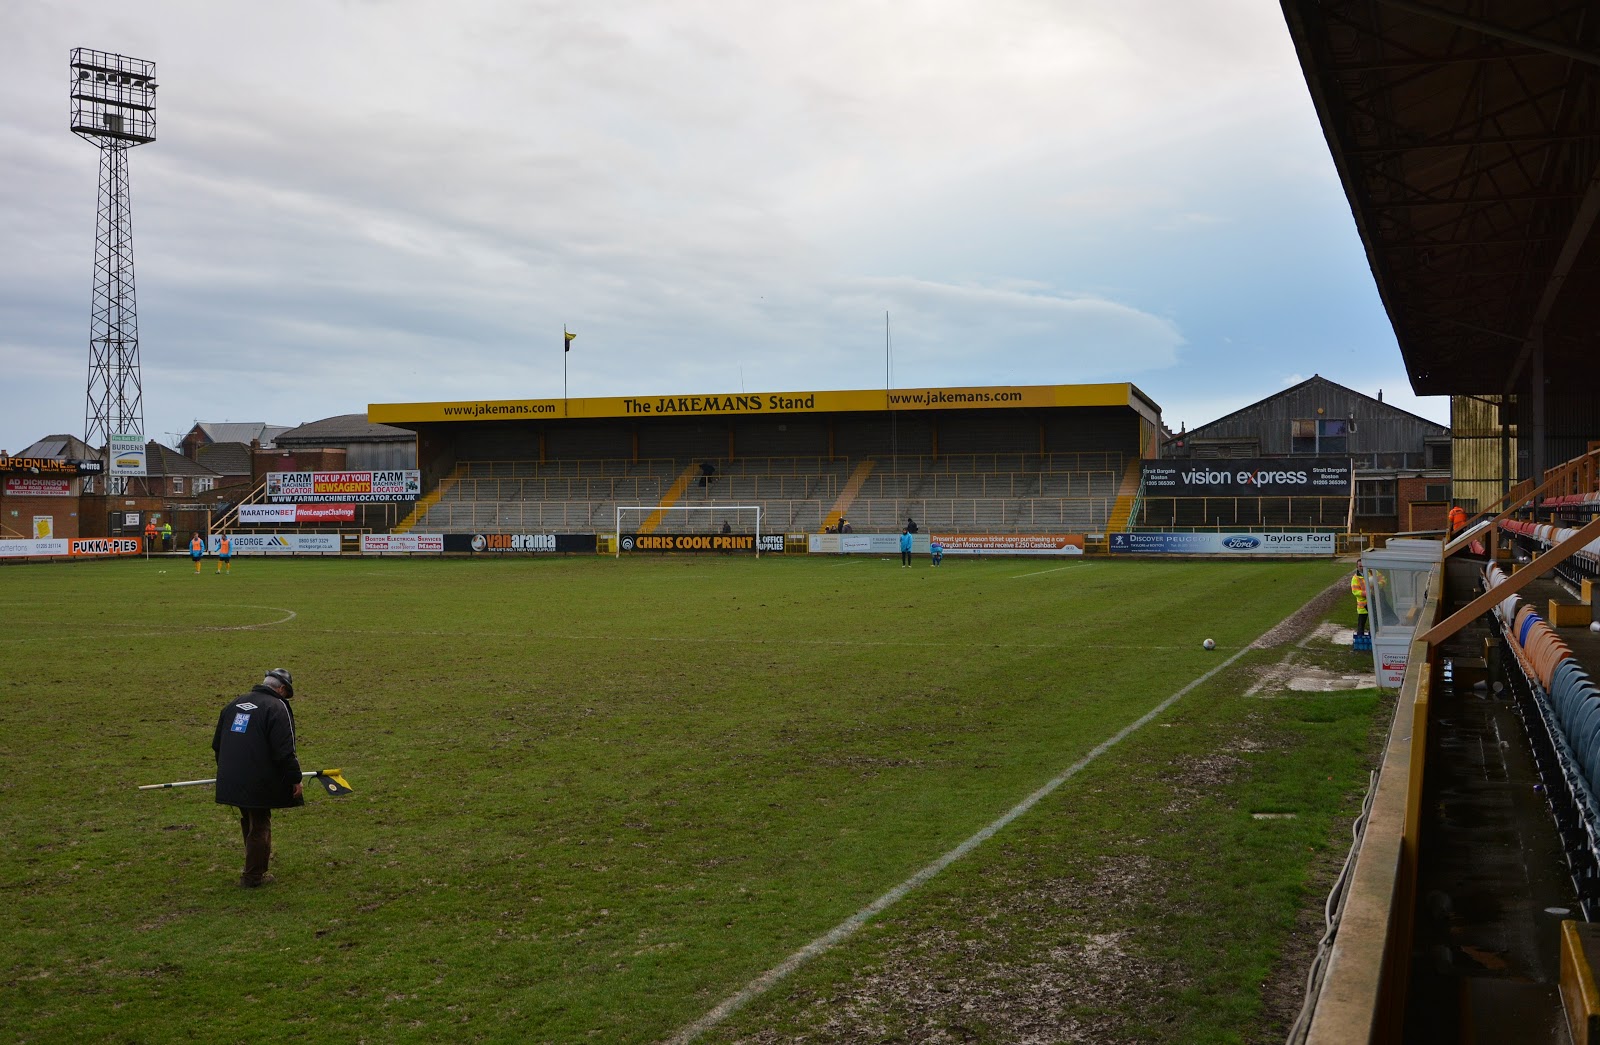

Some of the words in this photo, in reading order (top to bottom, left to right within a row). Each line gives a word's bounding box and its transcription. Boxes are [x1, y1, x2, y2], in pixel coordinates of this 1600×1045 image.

[624, 400, 651, 413] The
[656, 395, 762, 413] JAKEMANS
[769, 394, 815, 410] Stand
[890, 391, 1022, 406] www.jakemans.com
[444, 404, 556, 417] www.jakemans.com
[282, 474, 312, 483] FARM
[315, 474, 329, 483] PICK
[330, 474, 340, 482] UP
[341, 474, 350, 482] AT
[351, 473, 370, 482] YOUR
[373, 472, 403, 481] FARM
[1181, 468, 1231, 485] vision
[1236, 468, 1307, 488] express
[23, 479, 68, 487] DICKINSON
[315, 482, 371, 493] NEWSAGENTS
[271, 493, 416, 503] WWW.FARMMACHINERYLOCATOR.CO.UK
[240, 509, 295, 517] MARATHONBET
[296, 508, 354, 517] #NonLeagueChallenge
[234, 538, 263, 546] GEORGE
[486, 534, 556, 548] vanarama
[636, 536, 674, 549] CHRIS
[675, 536, 712, 549] COOK
[713, 536, 754, 549] PRINT
[762, 536, 784, 544] OFFICE
[1020, 535, 1050, 543] purchasing
[1228, 537, 1254, 549] Ford
[1264, 534, 1303, 543] Taylors
[1306, 534, 1331, 542] Ford
